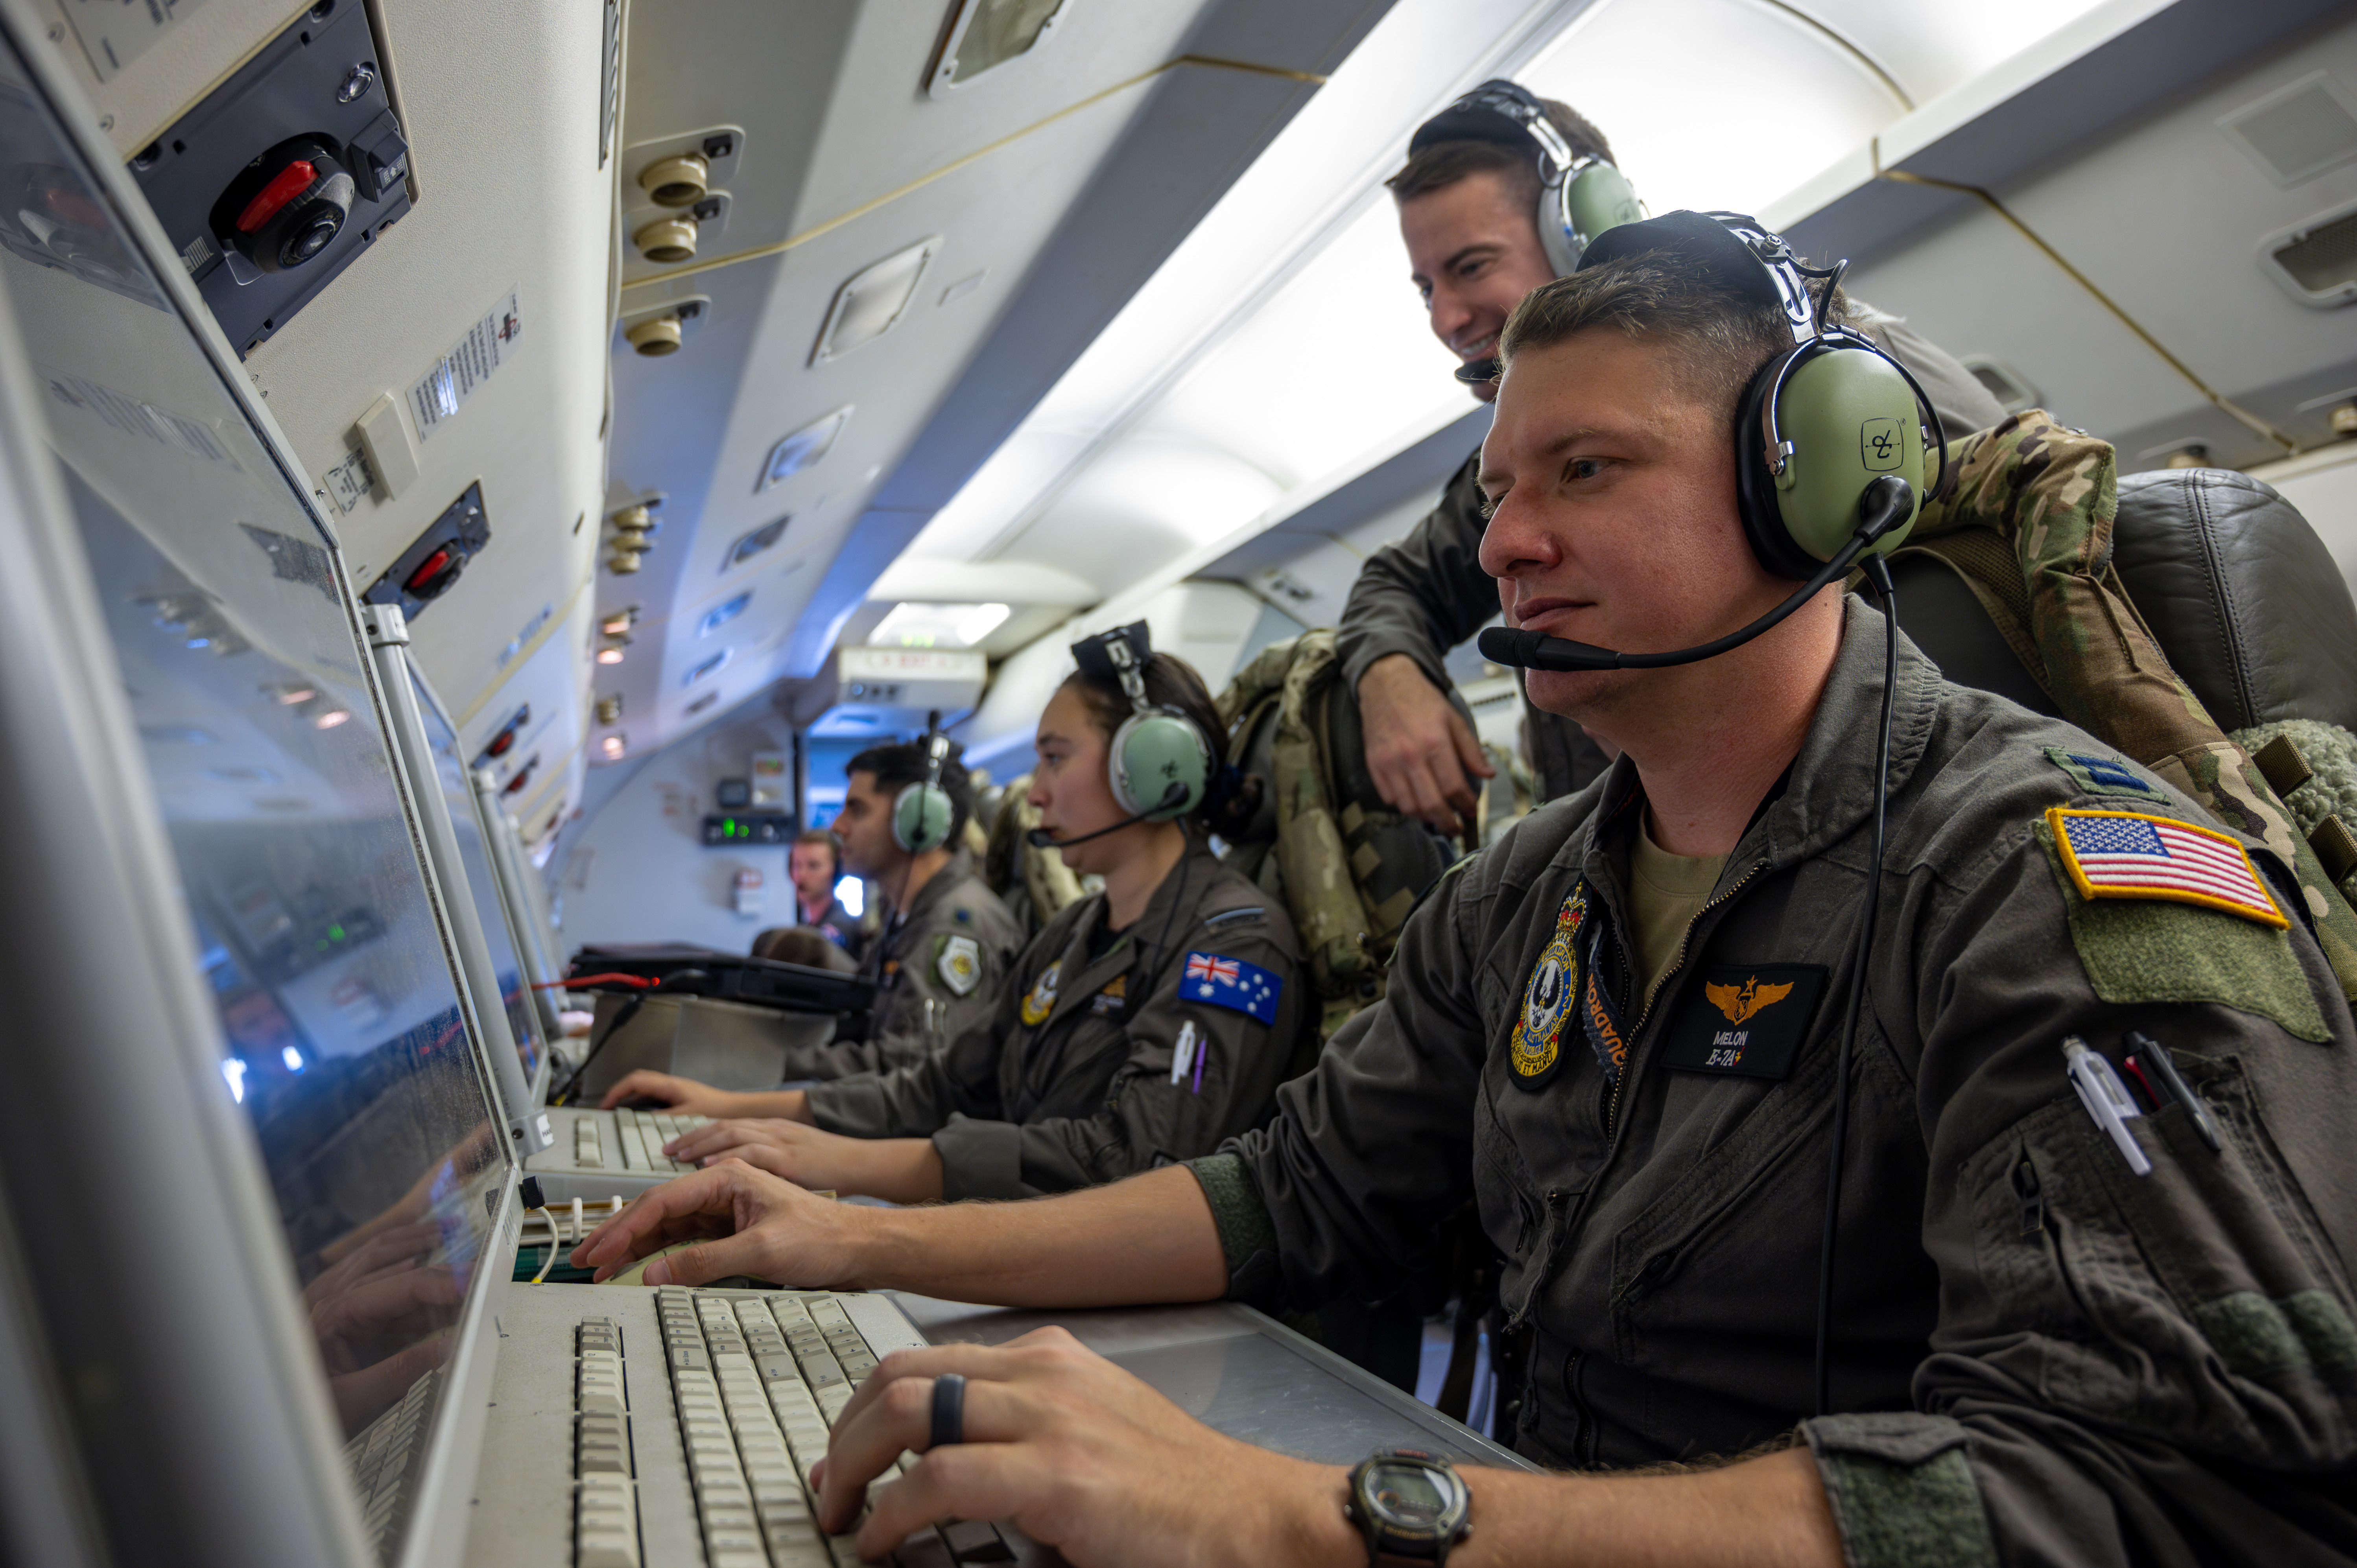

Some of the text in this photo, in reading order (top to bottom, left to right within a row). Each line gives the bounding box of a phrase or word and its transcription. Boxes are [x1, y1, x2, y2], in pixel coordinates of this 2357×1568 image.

[1541, 945, 1570, 972] SQUADRON
[1562, 996, 1569, 1008] 2
[1527, 1014, 1559, 1043] AUSTRALIAN
[1588, 973, 1626, 1067] QUADRON
[1713, 1031, 1748, 1046] MELON
[1527, 1044, 1542, 1055] FORCE
[1706, 1048, 1736, 1067] E-7A
[1523, 1063, 1531, 1074] ET
[1532, 1051, 1552, 1074] MANU
